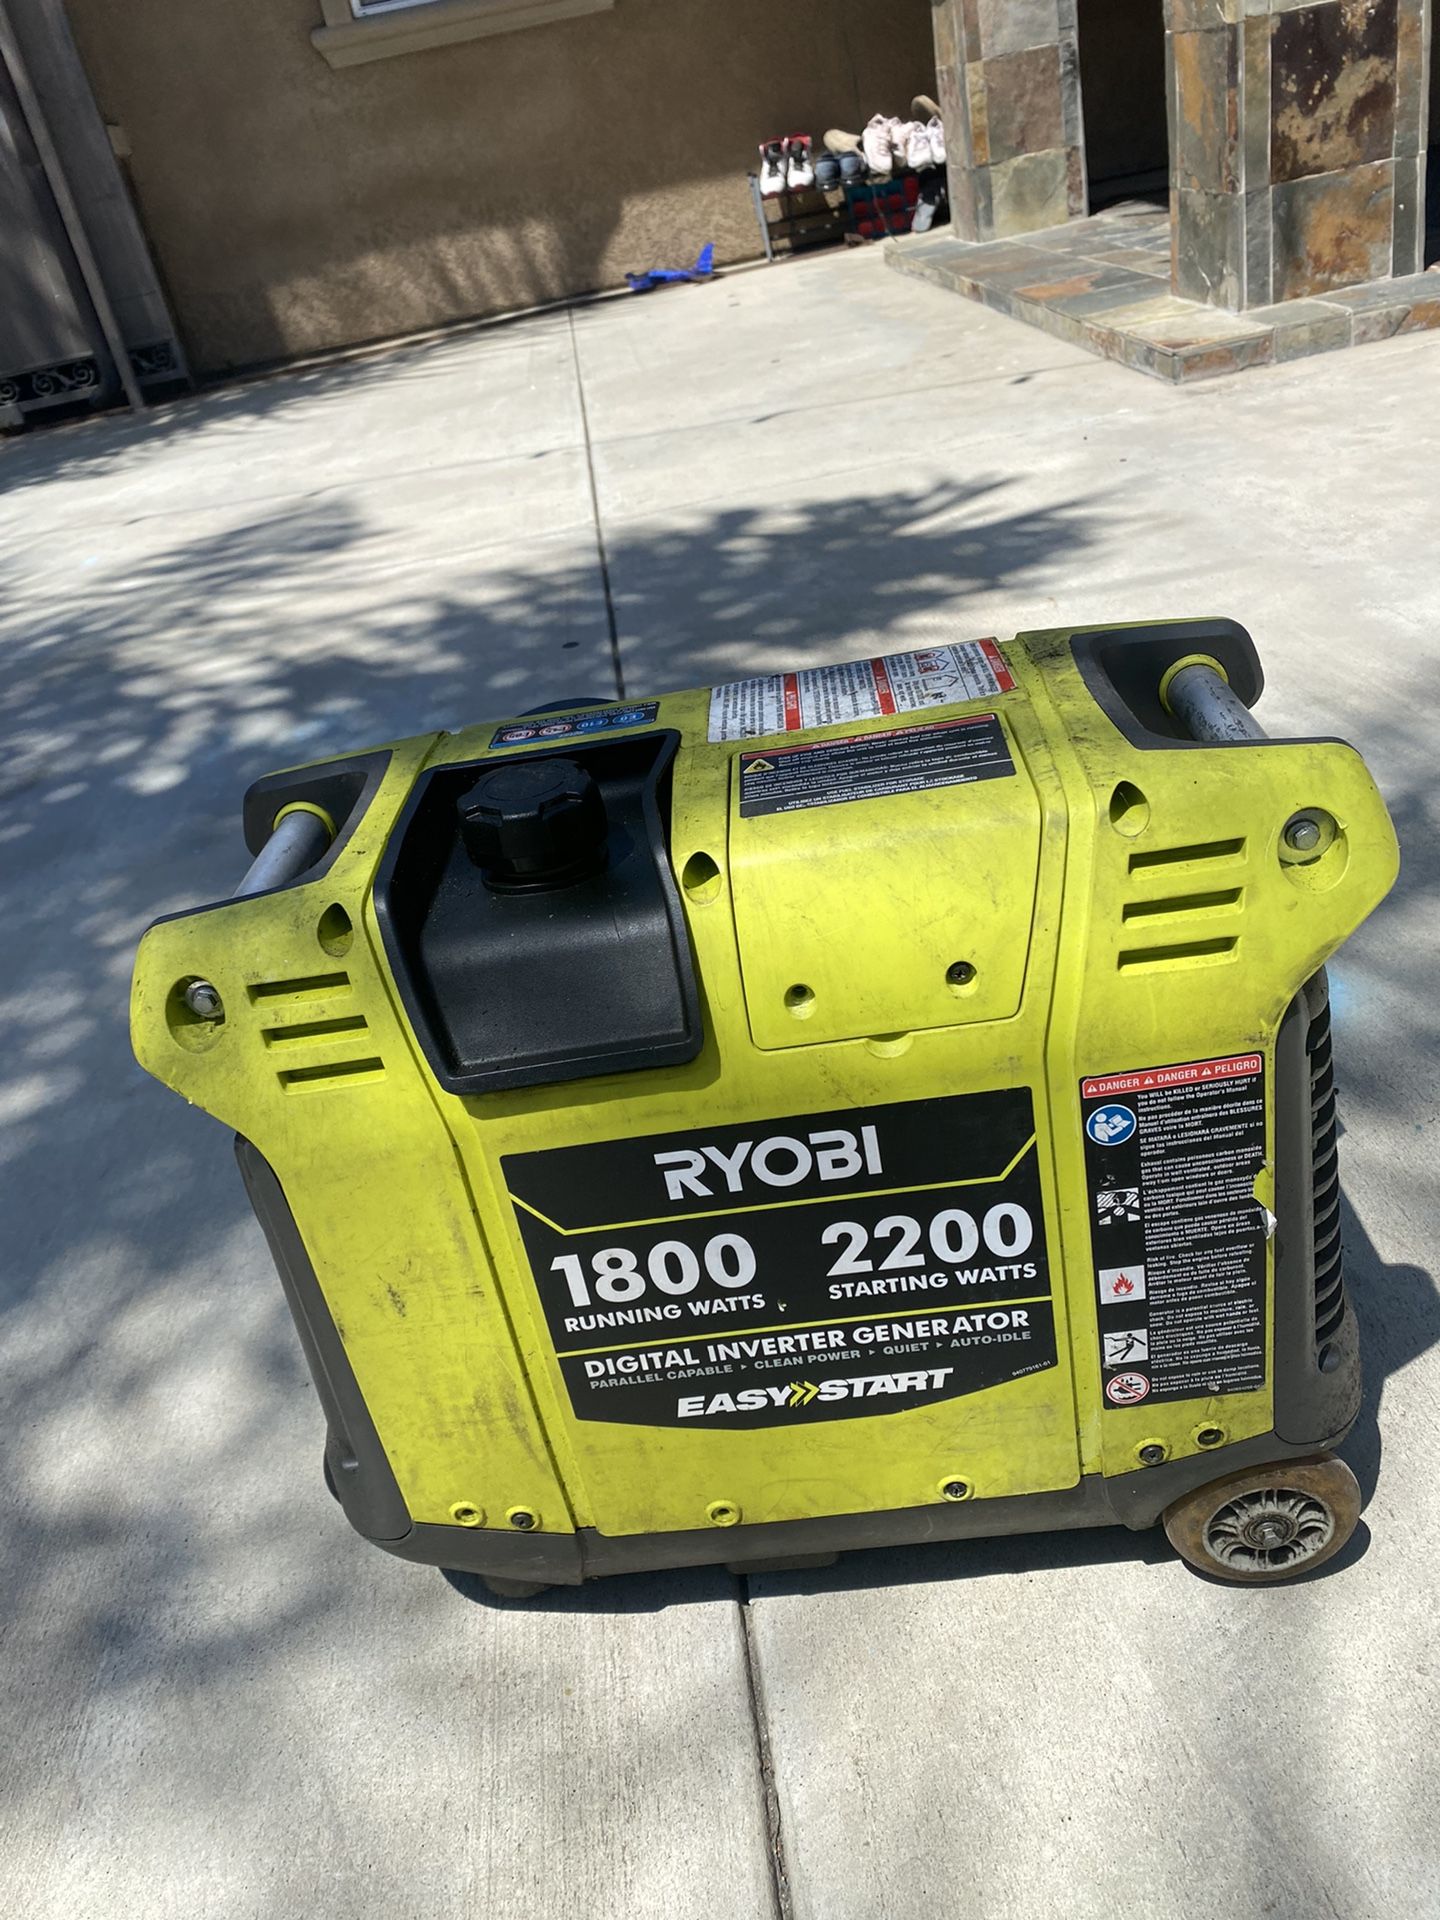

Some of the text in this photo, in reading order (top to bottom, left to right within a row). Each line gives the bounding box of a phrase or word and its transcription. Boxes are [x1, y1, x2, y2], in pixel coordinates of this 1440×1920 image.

[1099, 1059, 1256, 1091] DANGER DANGER PELIGRO
[653, 1125, 883, 1200] RYOBI
[550, 1203, 1034, 1308] 1800 2200
[828, 1262, 1037, 1300] STARTING WATTS
[564, 1294, 766, 1333] RUNNING WATTS
[584, 1310, 1030, 1378] DIGITAL INVERTER GENERATOR
[590, 1331, 1032, 1390] PARALLEL CAPABLE CLEAN POWER QUIET AUTO-IDLE
[677, 1368, 954, 1418] EASY START
